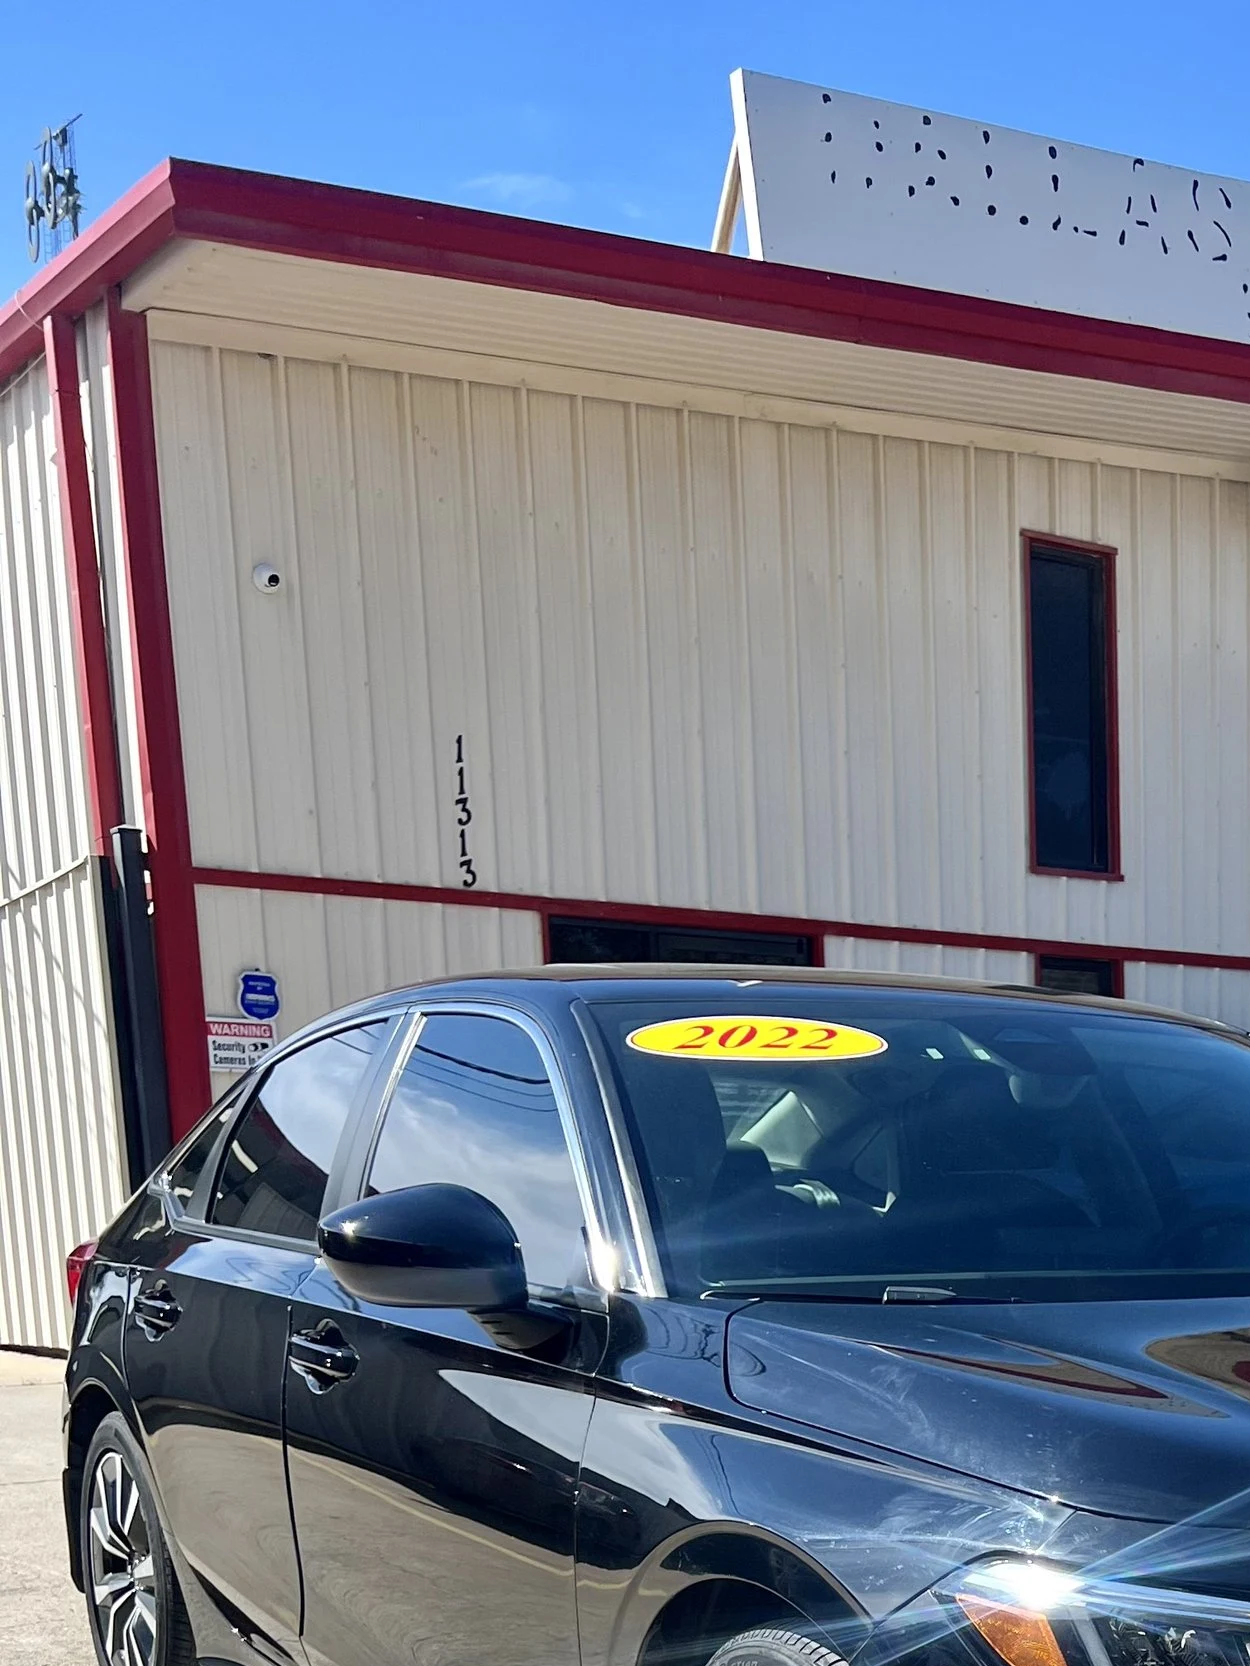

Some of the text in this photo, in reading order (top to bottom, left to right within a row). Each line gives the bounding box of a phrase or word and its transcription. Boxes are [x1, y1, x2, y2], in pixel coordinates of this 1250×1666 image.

[455, 734, 477, 888] 11313
[209, 1022, 271, 1038] WARNING
[673, 1024, 838, 1051] 2022
[212, 1039, 246, 1054] Security
[213, 1053, 246, 1066] Cameras
